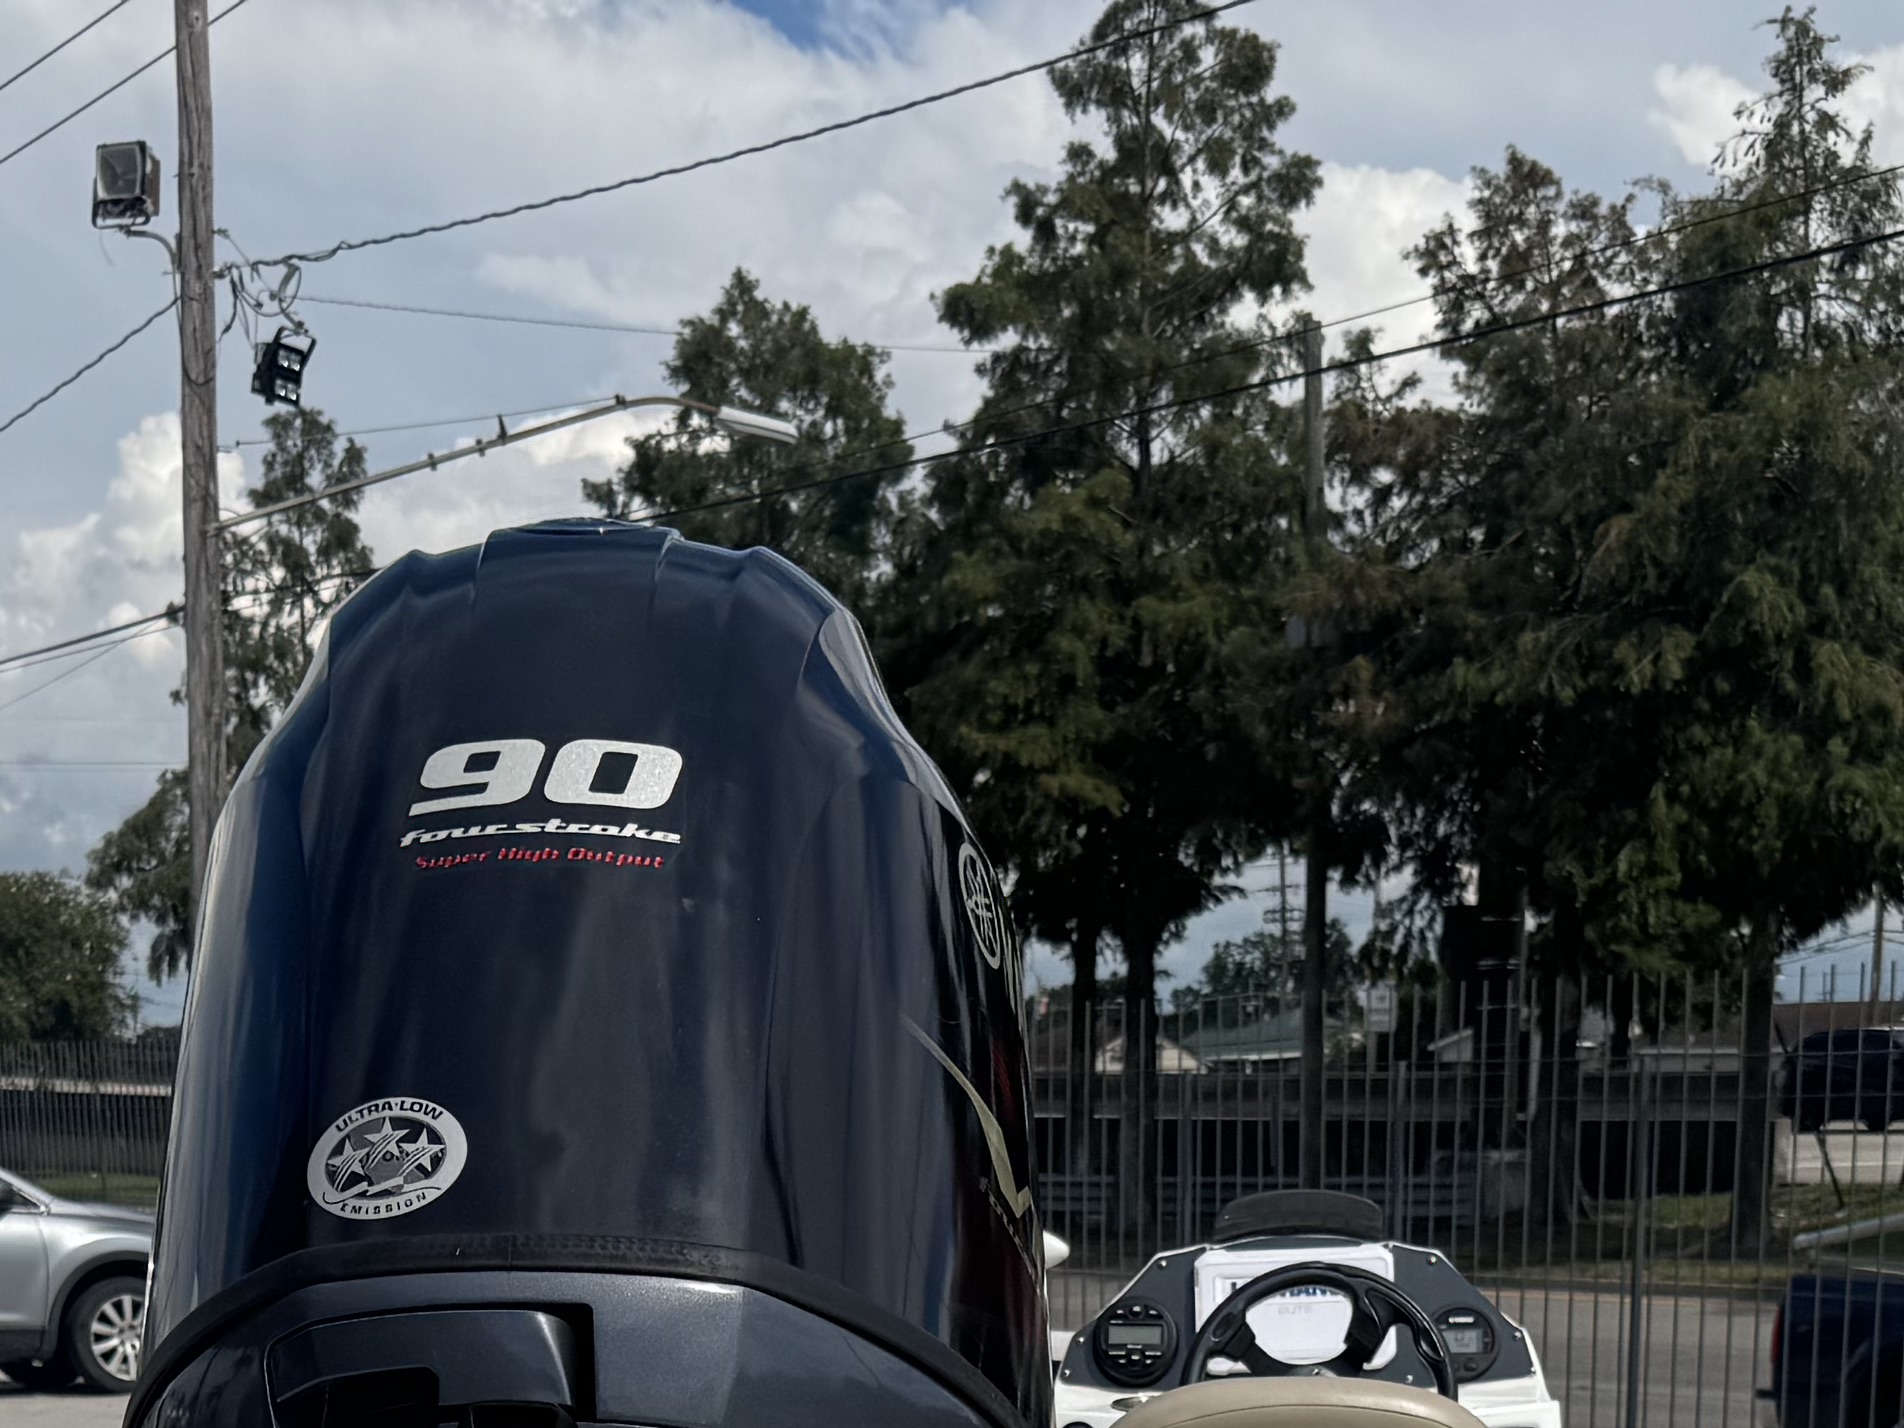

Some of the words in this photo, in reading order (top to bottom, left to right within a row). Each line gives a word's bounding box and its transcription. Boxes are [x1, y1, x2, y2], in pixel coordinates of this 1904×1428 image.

[409, 738, 683, 817] 90
[415, 852, 490, 869] Super
[497, 847, 560, 863] High
[566, 847, 665, 869] Output
[340, 1191, 428, 1216] EMISSION
